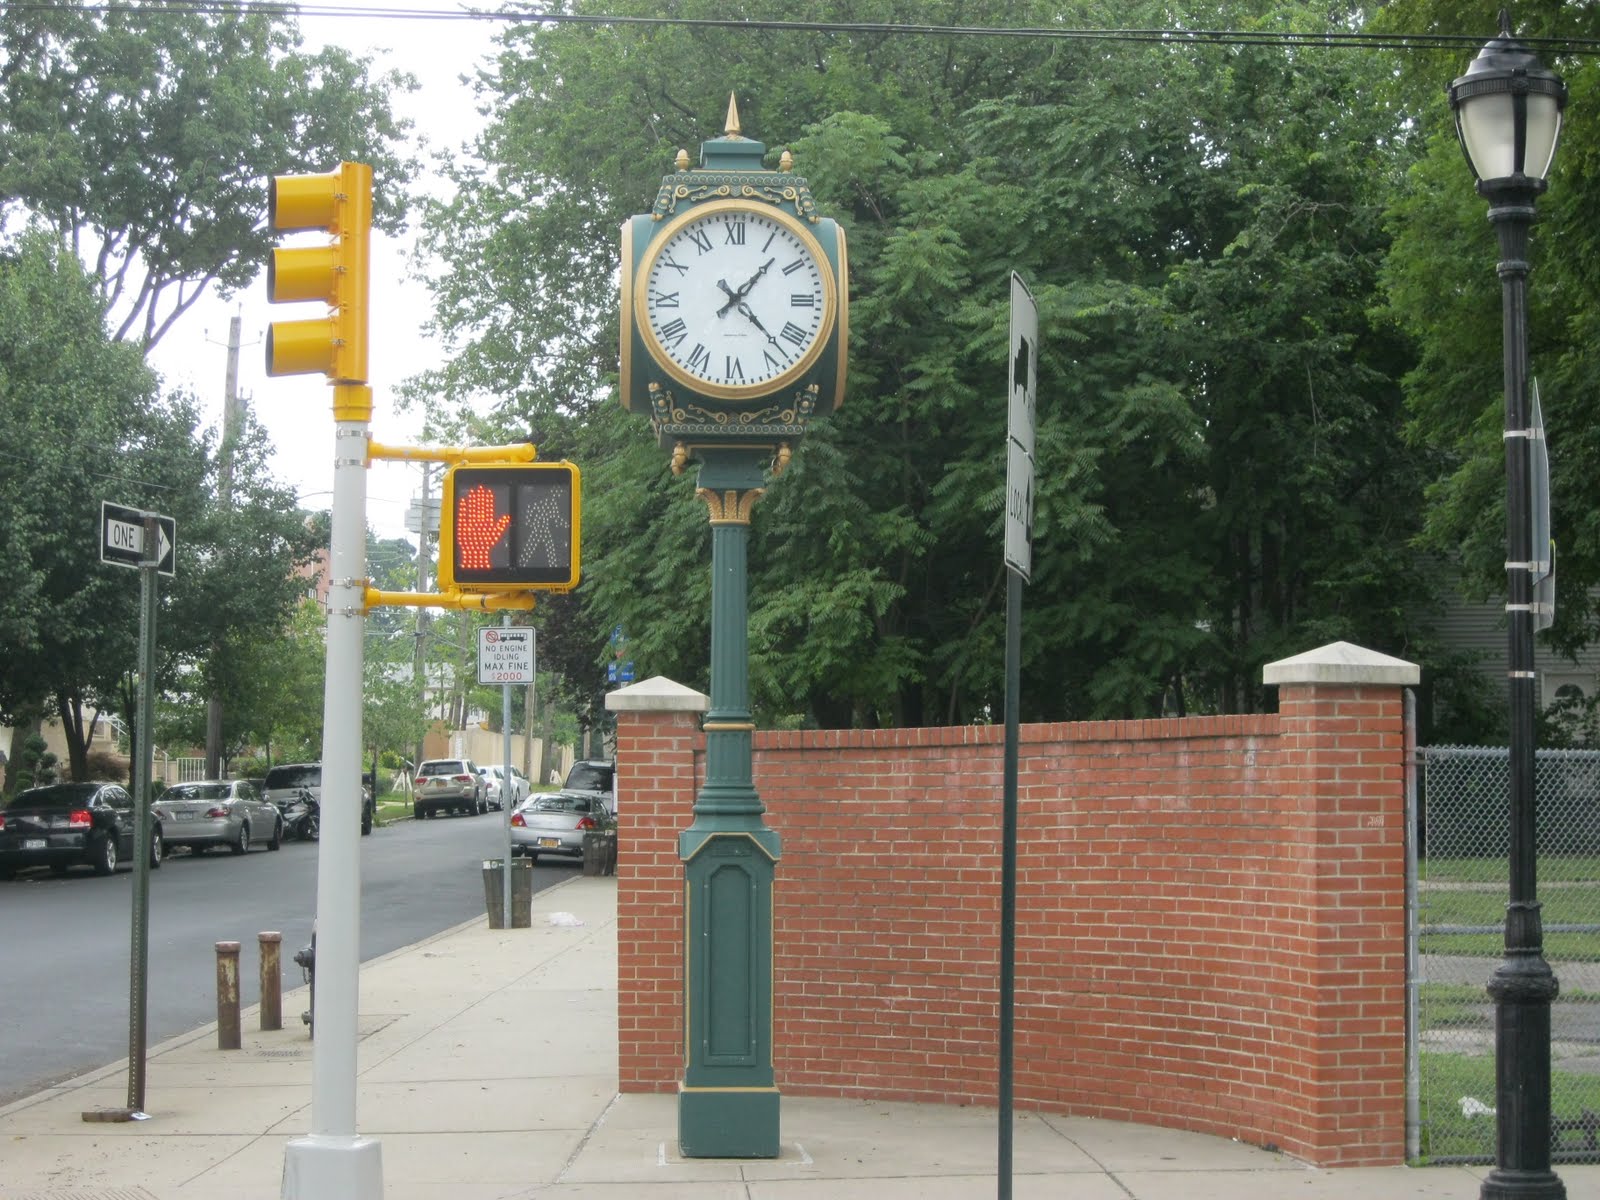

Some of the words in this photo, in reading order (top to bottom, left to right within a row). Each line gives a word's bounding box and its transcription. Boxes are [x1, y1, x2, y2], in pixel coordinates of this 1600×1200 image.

[688, 228, 713, 256] XI
[724, 222, 746, 245] XII
[664, 256, 689, 277] X
[781, 258, 805, 276] II
[655, 291, 680, 308] IX
[790, 294, 815, 307] III
[686, 343, 711, 373] VII
[725, 355, 744, 379] VI
[763, 349, 780, 371] V
[114, 524, 134, 548] ONE
[484, 662, 504, 670] MAX
[508, 662, 528, 670] FINE
[494, 653, 519, 661] IDLING
